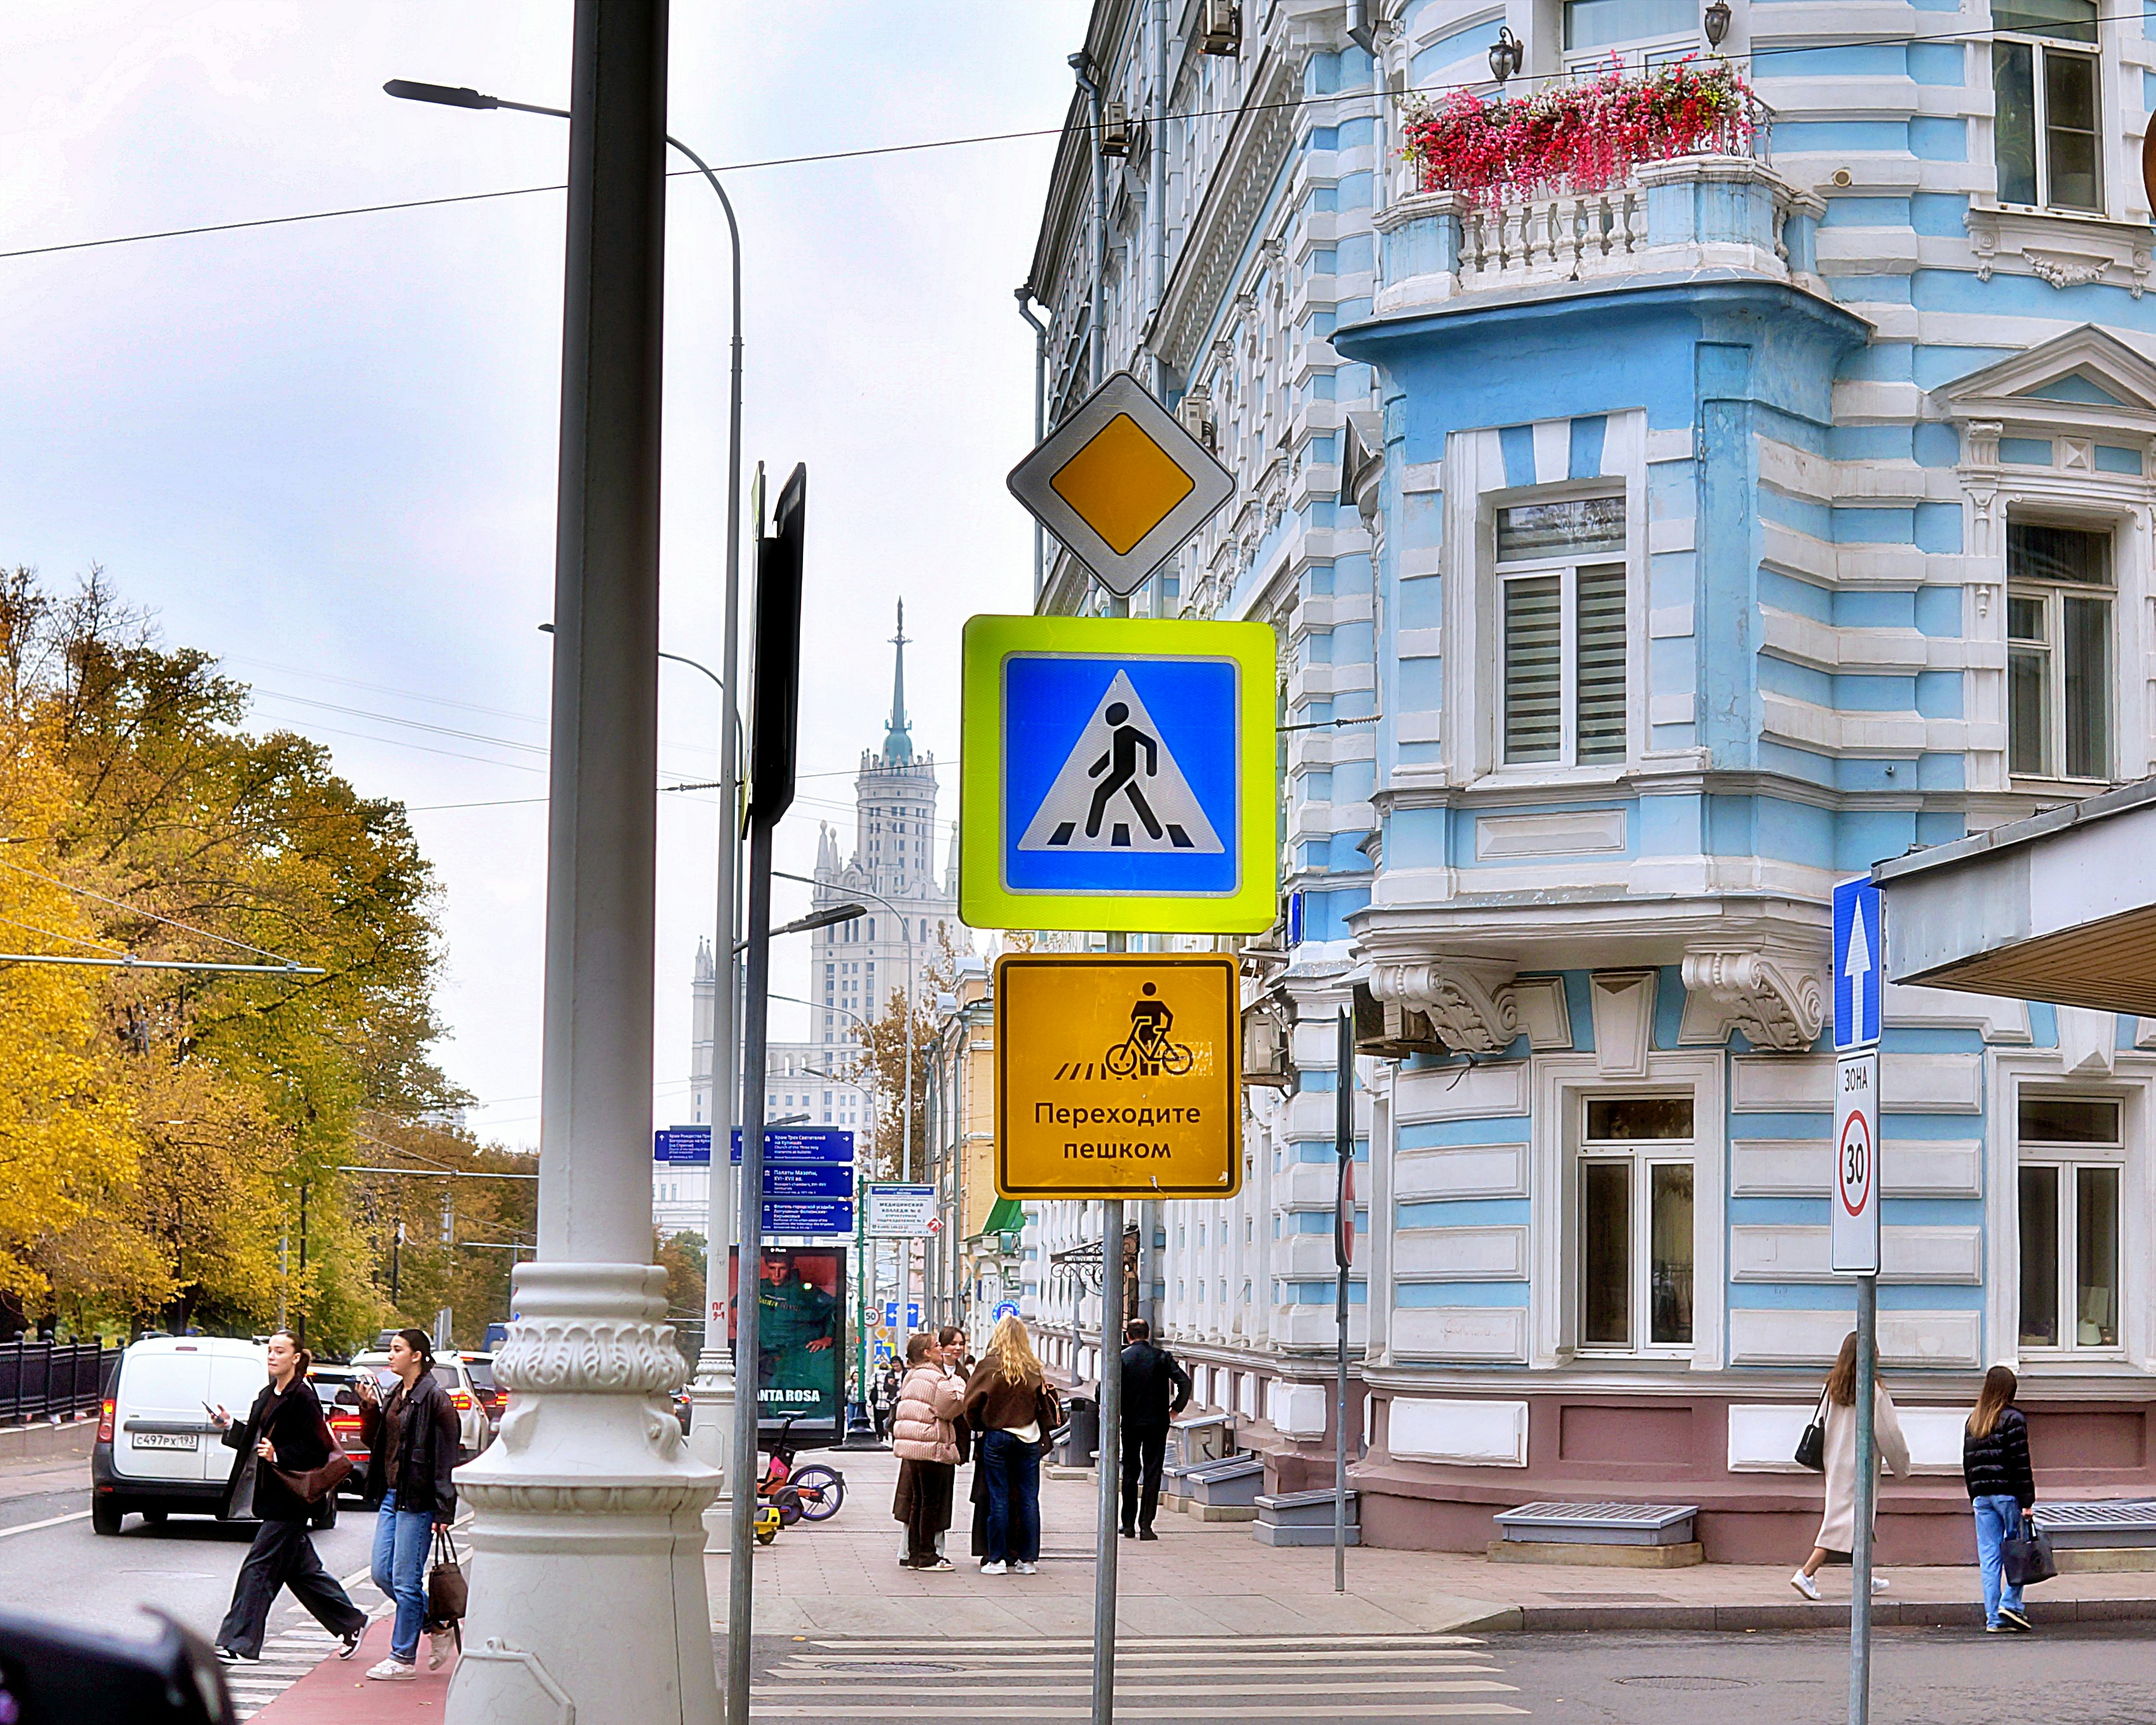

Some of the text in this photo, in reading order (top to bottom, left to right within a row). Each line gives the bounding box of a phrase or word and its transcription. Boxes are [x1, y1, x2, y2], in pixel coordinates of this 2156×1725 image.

[1844, 1065, 1868, 1092] ЗОНА
[1035, 1102, 1201, 1129] Переходите
[1064, 1142, 1172, 1159] пешком
[1846, 1142, 1864, 1184] 30
[712, 1301, 724, 1311] ПГ
[785, 1389, 820, 1402] ROSA
[136, 1435, 195, 1446] С497РХ 193
